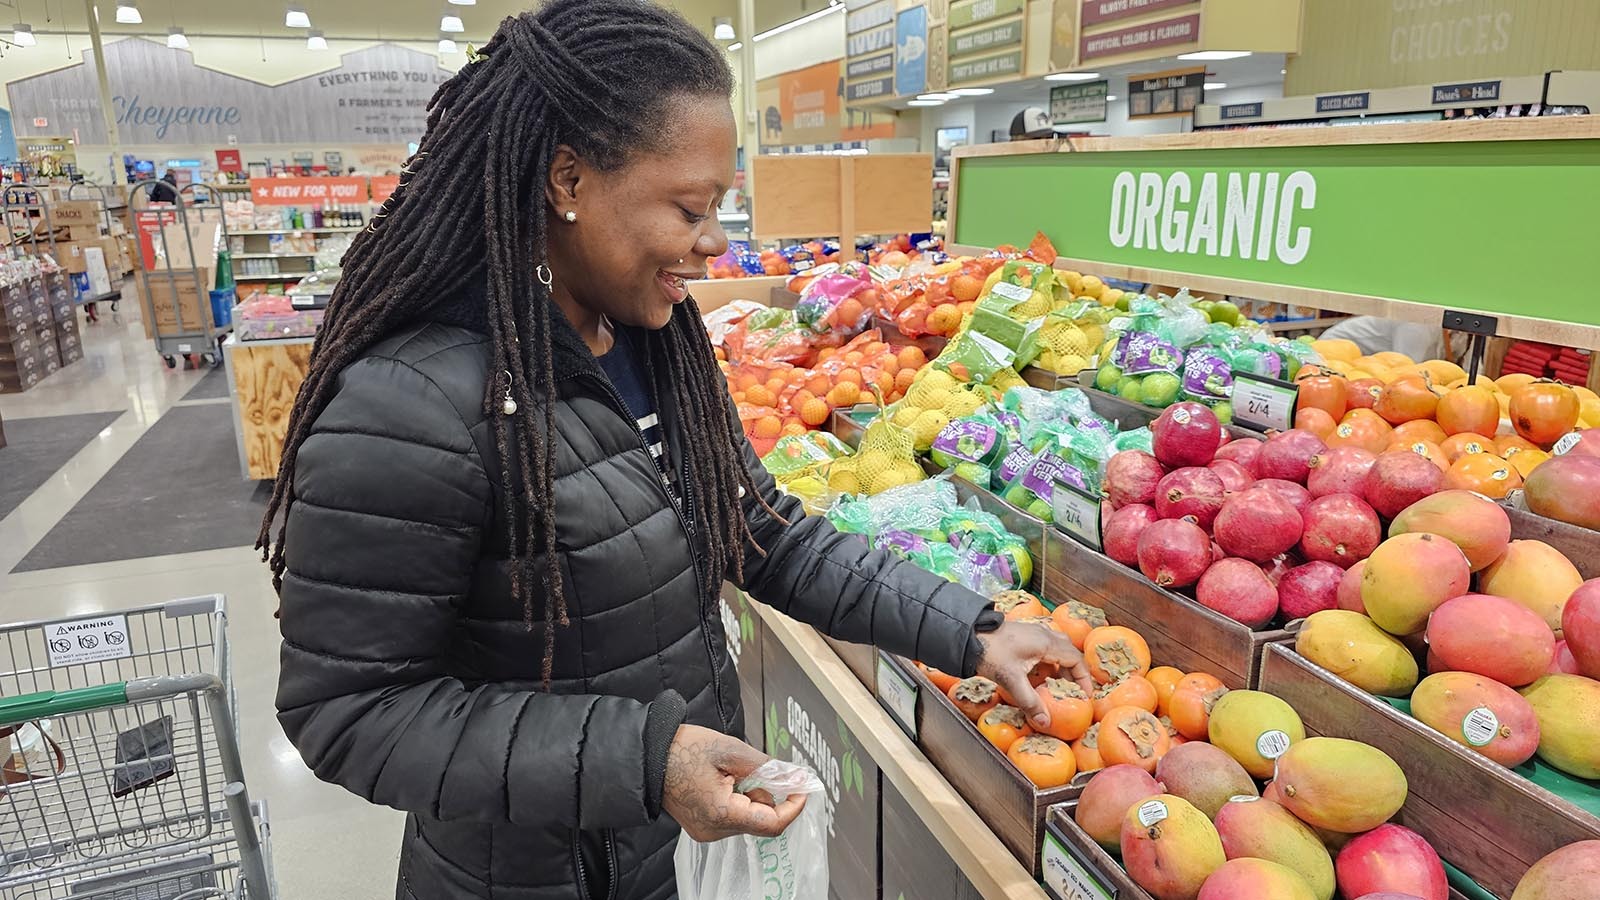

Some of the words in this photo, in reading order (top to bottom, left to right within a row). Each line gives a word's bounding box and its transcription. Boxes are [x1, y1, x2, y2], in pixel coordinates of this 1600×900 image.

[1086, 37, 1121, 52] ARTIFICIAL
[1122, 30, 1149, 46] COLORS
[1157, 22, 1191, 40] FLAVORS
[1391, 12, 1511, 62] CHOICES
[319, 71, 399, 87] EVERYTHING
[403, 72, 428, 82] YOU
[112, 95, 241, 139] Cheyenne
[273, 186, 300, 198] NEW
[303, 185, 326, 198] FOR
[330, 184, 358, 197] YOU!
[1109, 171, 1317, 265] ORGANIC
[67, 620, 114, 631] WARNING
[787, 695, 840, 804] ORGANIC
